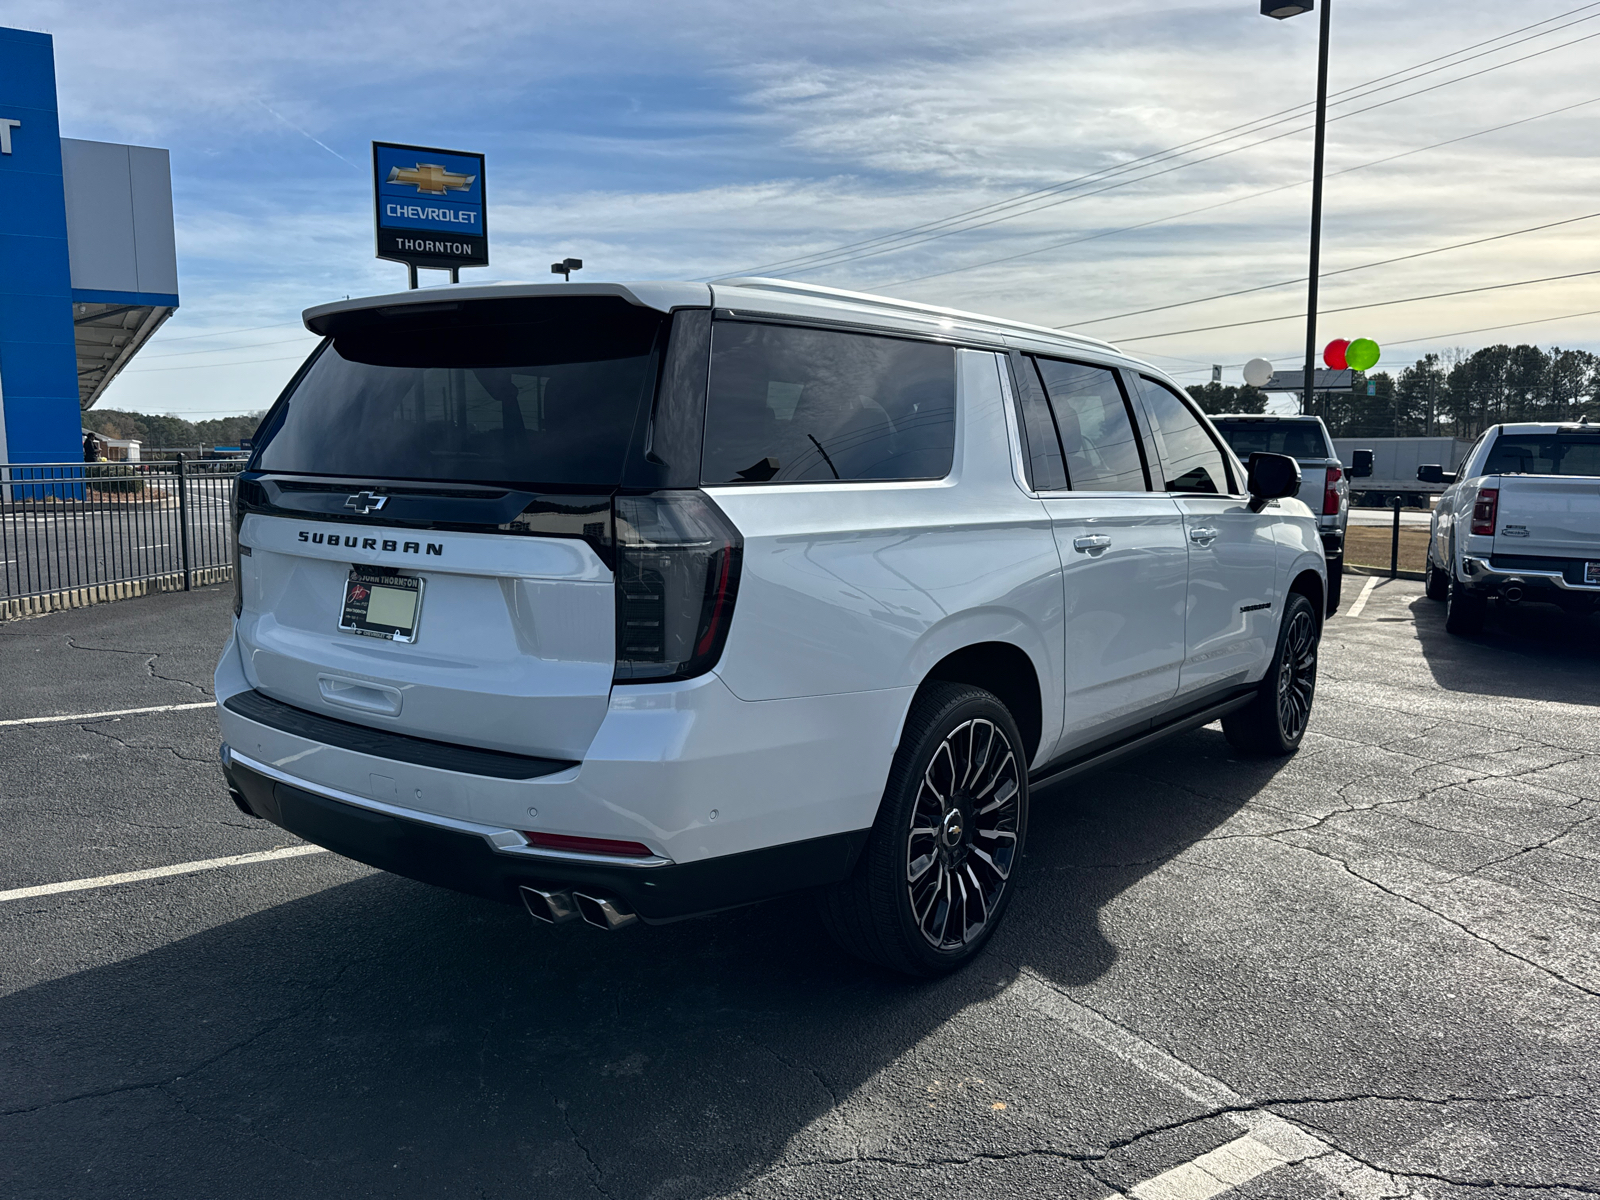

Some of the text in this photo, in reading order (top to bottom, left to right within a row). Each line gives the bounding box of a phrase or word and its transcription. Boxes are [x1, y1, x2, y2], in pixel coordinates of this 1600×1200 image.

[386, 203, 478, 224] CHEVROLET
[396, 237, 472, 255] THORNTON
[298, 531, 443, 556] SUBURBAN
